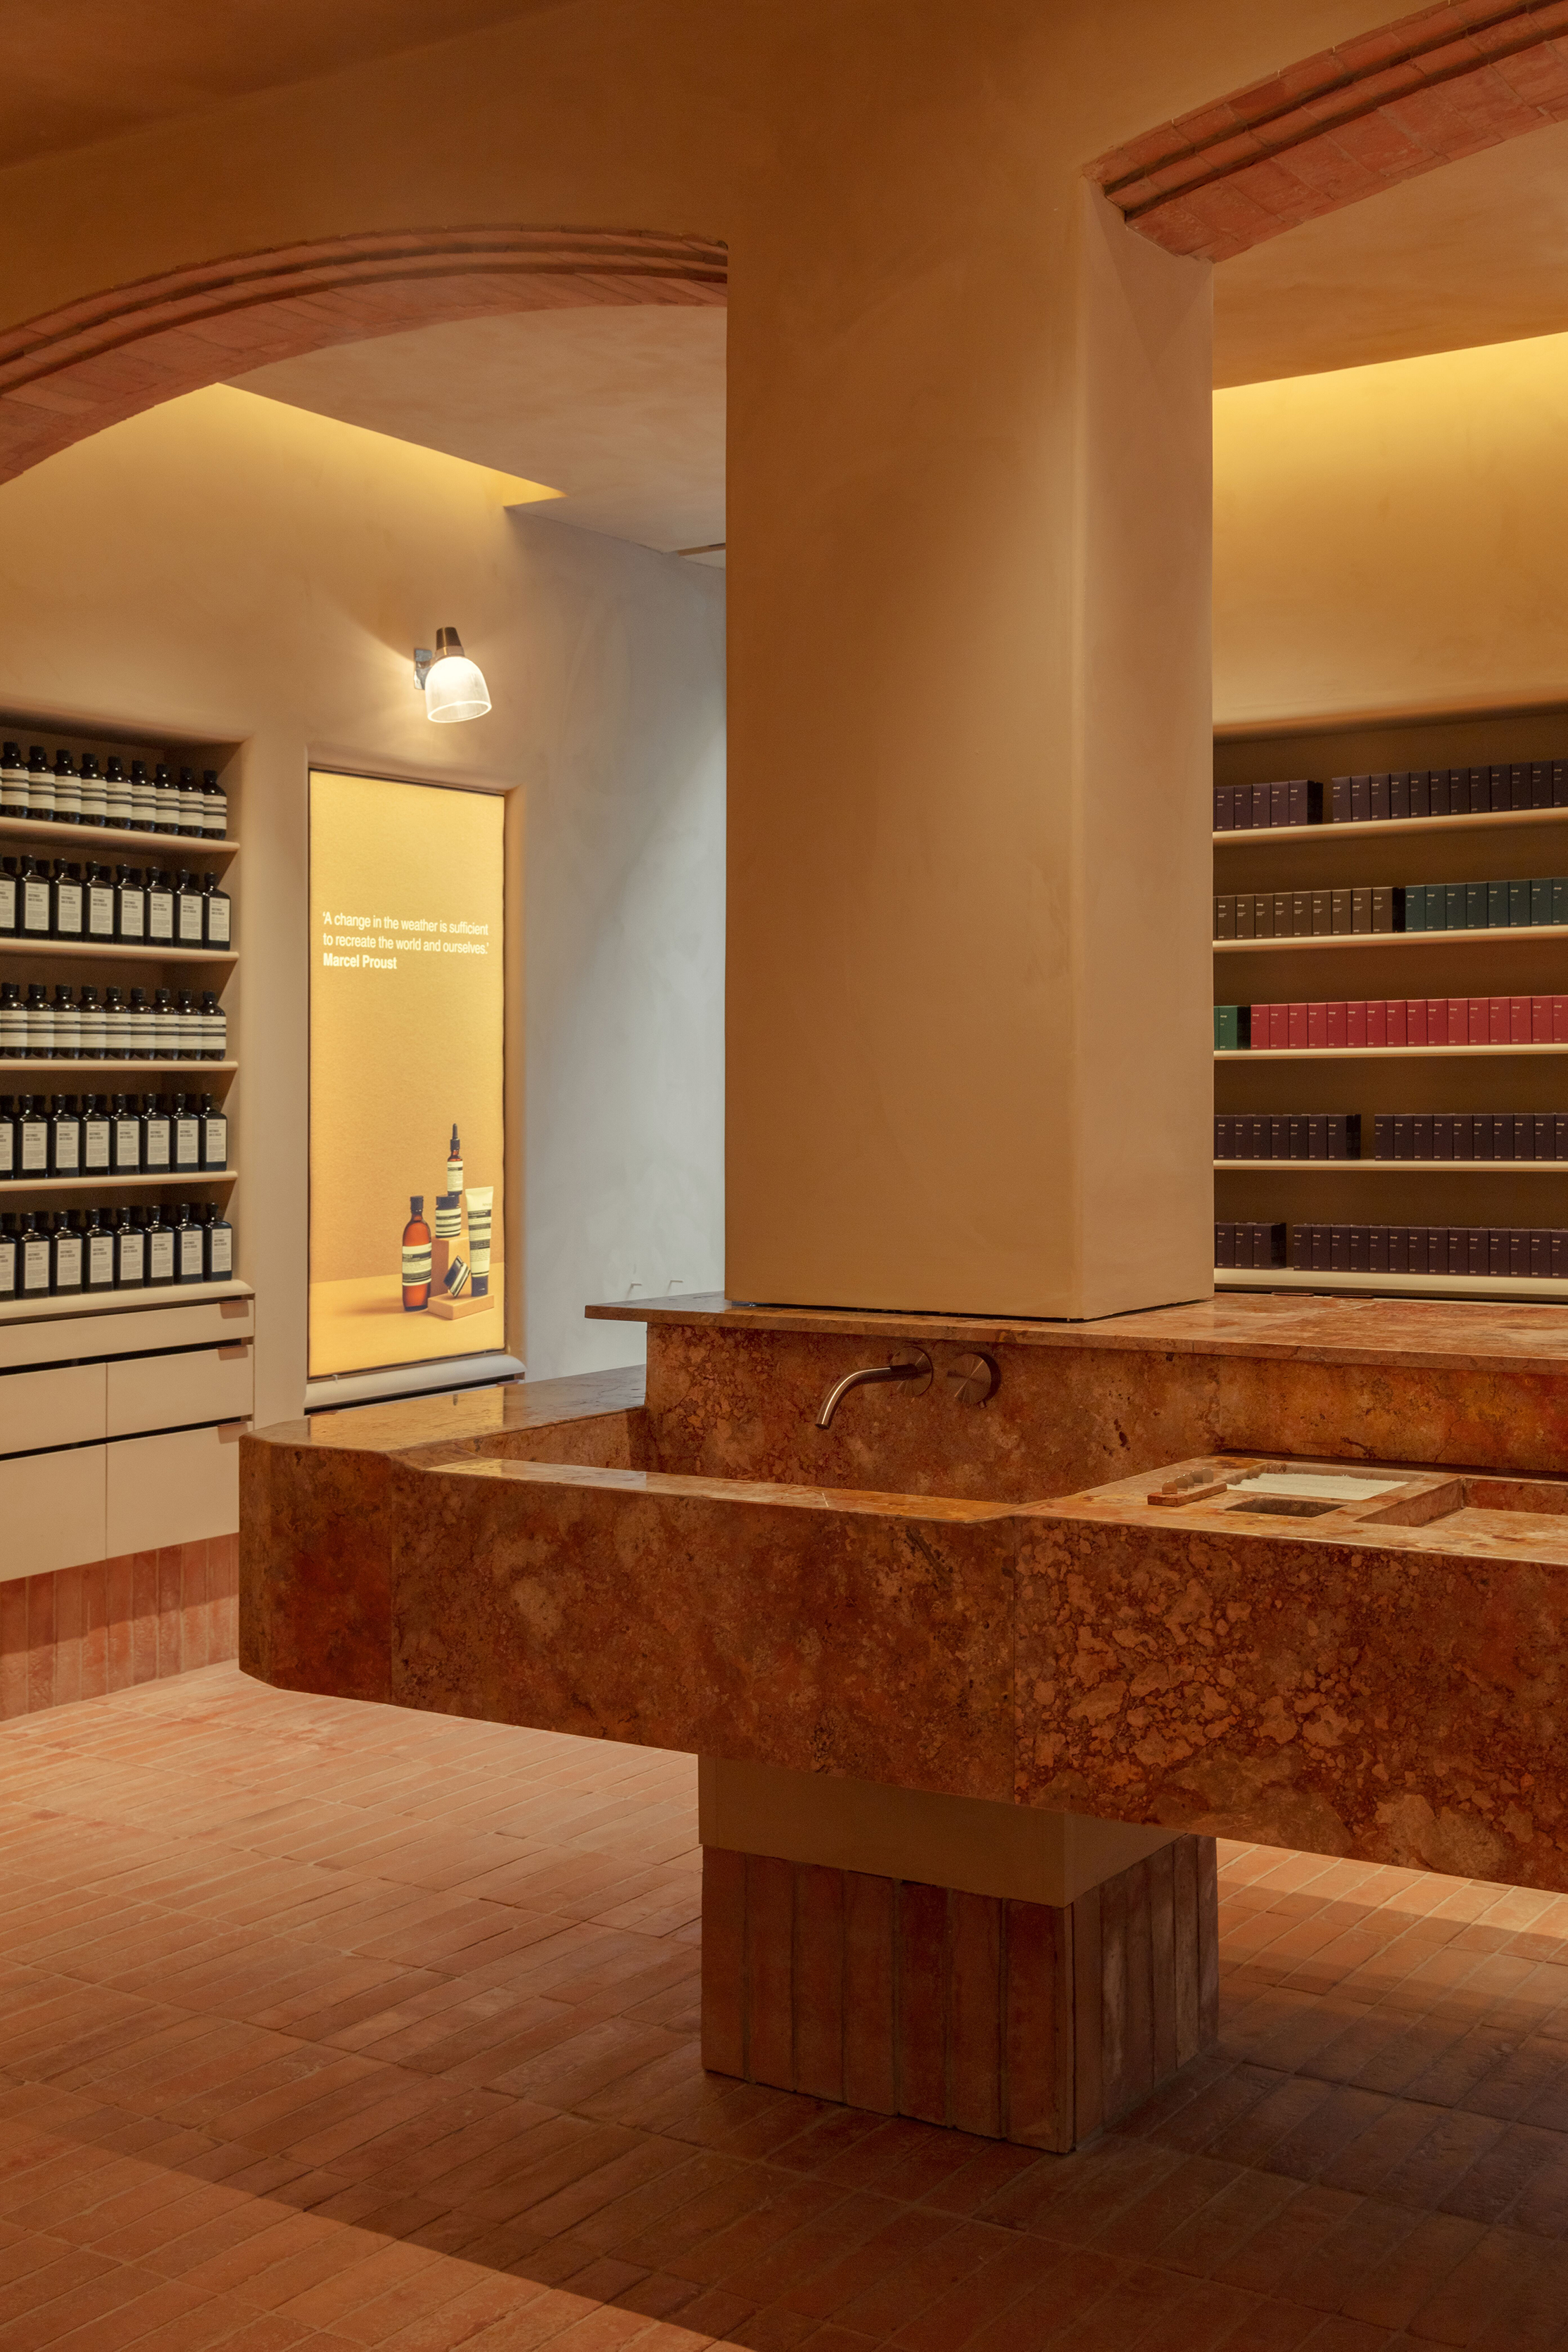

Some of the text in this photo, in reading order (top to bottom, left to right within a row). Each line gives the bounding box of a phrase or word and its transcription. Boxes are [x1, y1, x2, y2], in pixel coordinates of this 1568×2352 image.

[334, 912, 371, 930] change
[373, 914, 382, 928] in
[384, 916, 399, 929] the
[400, 919, 438, 932] weather
[439, 919, 448, 933] is
[449, 921, 488, 936] sufficient
[322, 933, 334, 946] to
[336, 935, 377, 948] recreate
[378, 936, 394, 949] the
[396, 938, 422, 951] world
[423, 939, 441, 952] and
[323, 952, 398, 969] Marcel Proust
